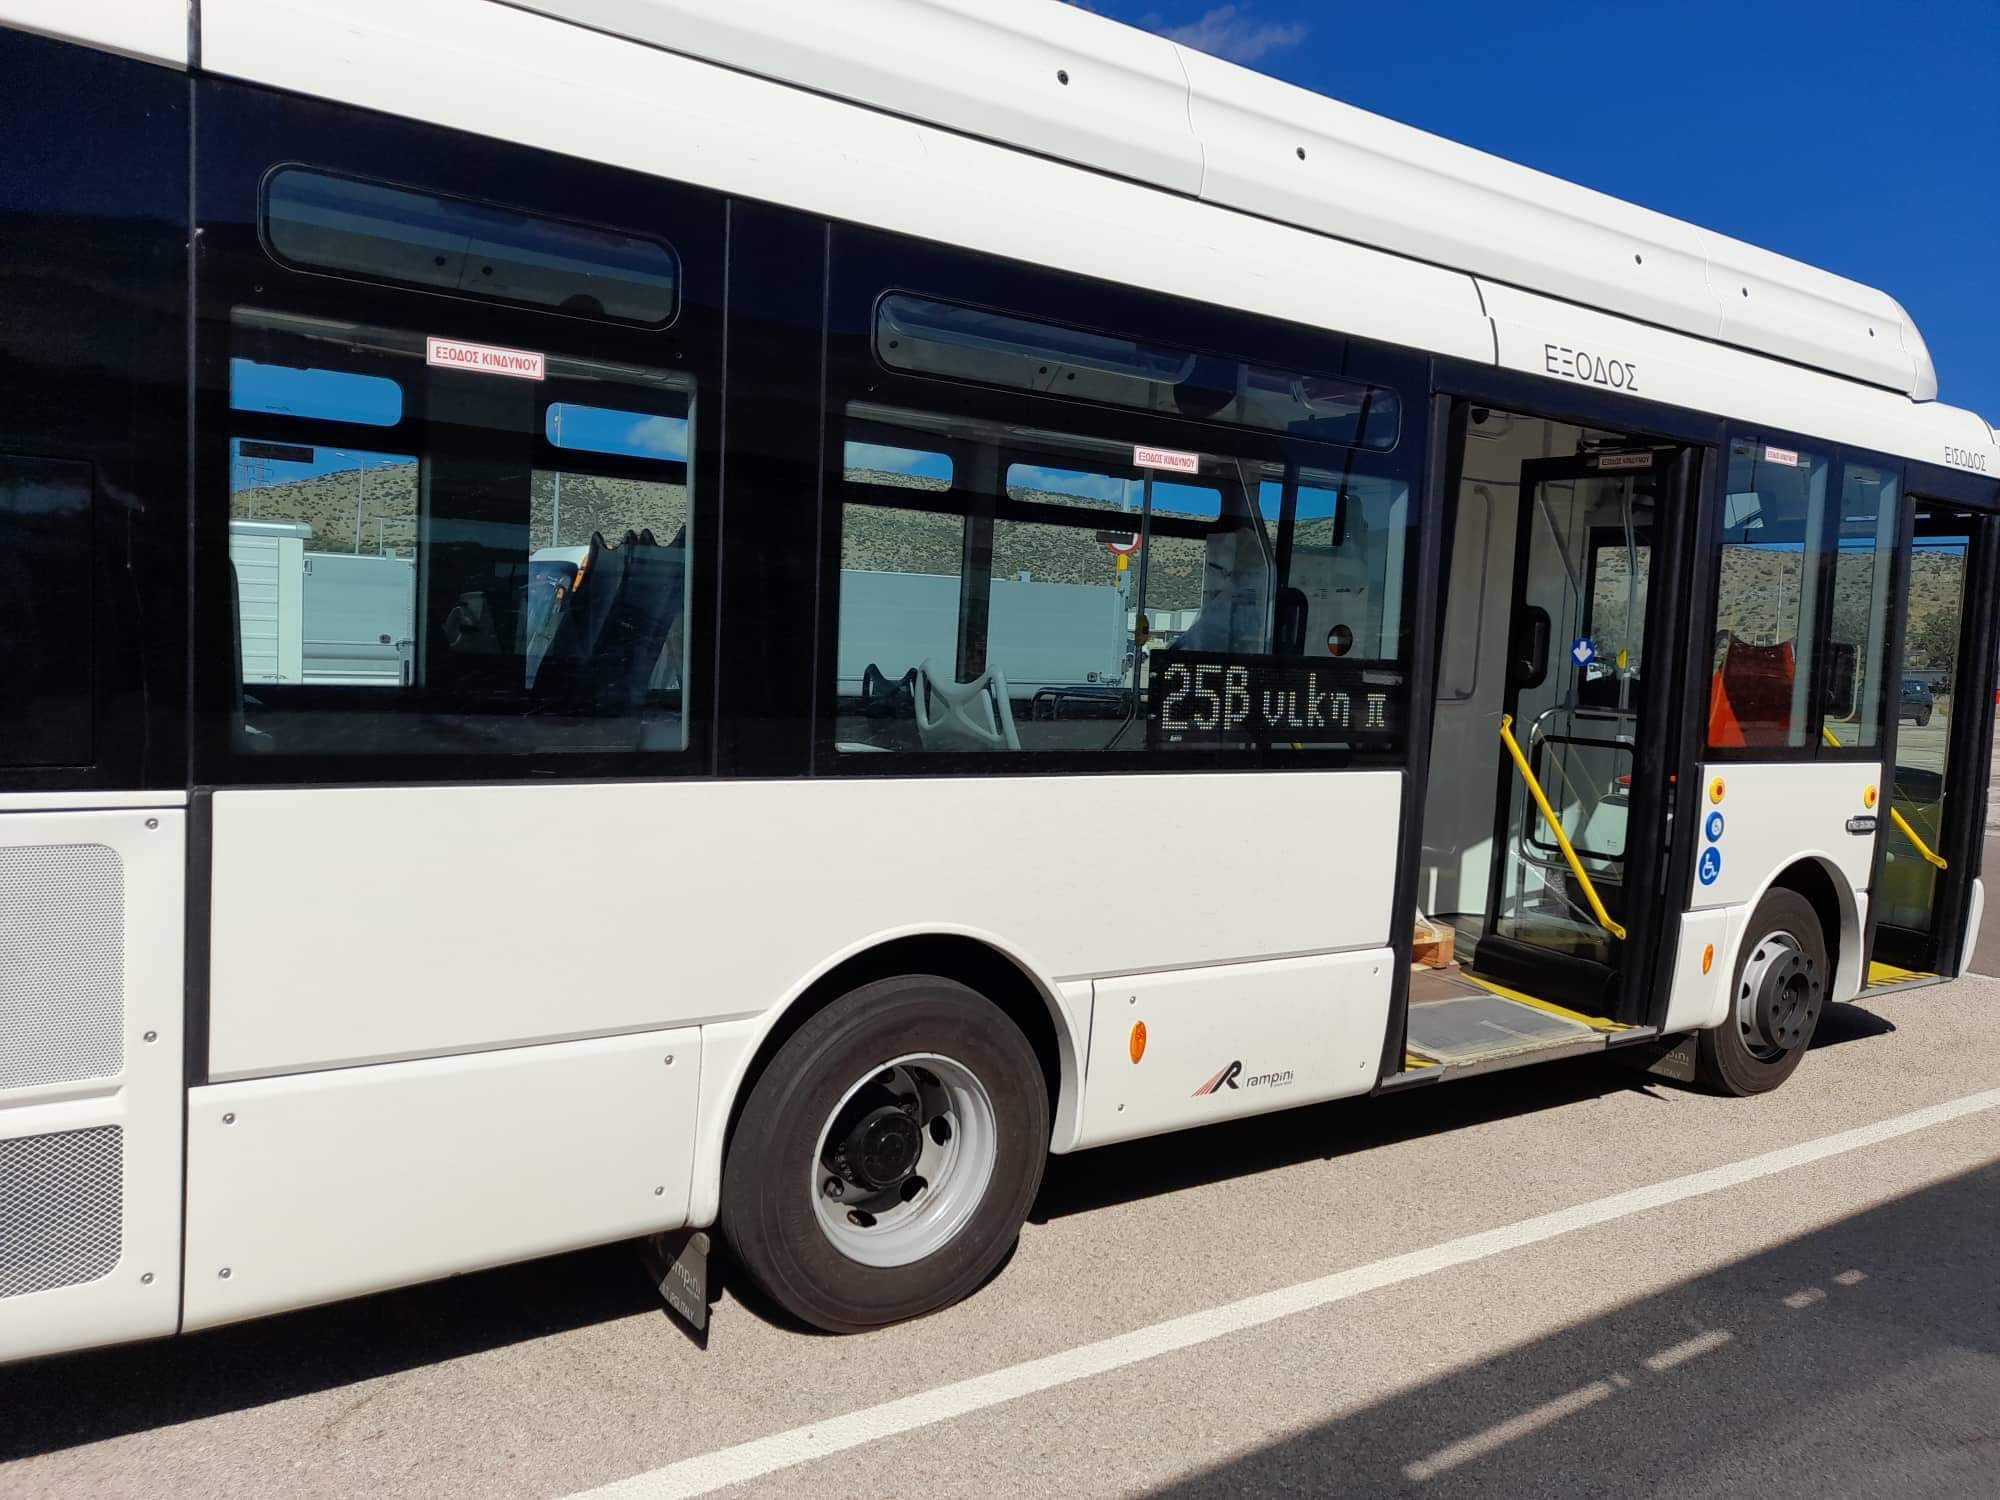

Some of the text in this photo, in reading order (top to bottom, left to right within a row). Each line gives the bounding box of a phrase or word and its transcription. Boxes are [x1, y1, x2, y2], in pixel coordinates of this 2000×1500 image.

[435, 346, 538, 372] ΕΞΟΔΟΣ ΚΙΝΔΥΝΟΥ
[1544, 343, 1639, 392] ΕΞΟΔΟΣ
[1944, 446, 1987, 472] ΕΙΣΟΔΟΣ
[1246, 1070, 1295, 1089] rampini
